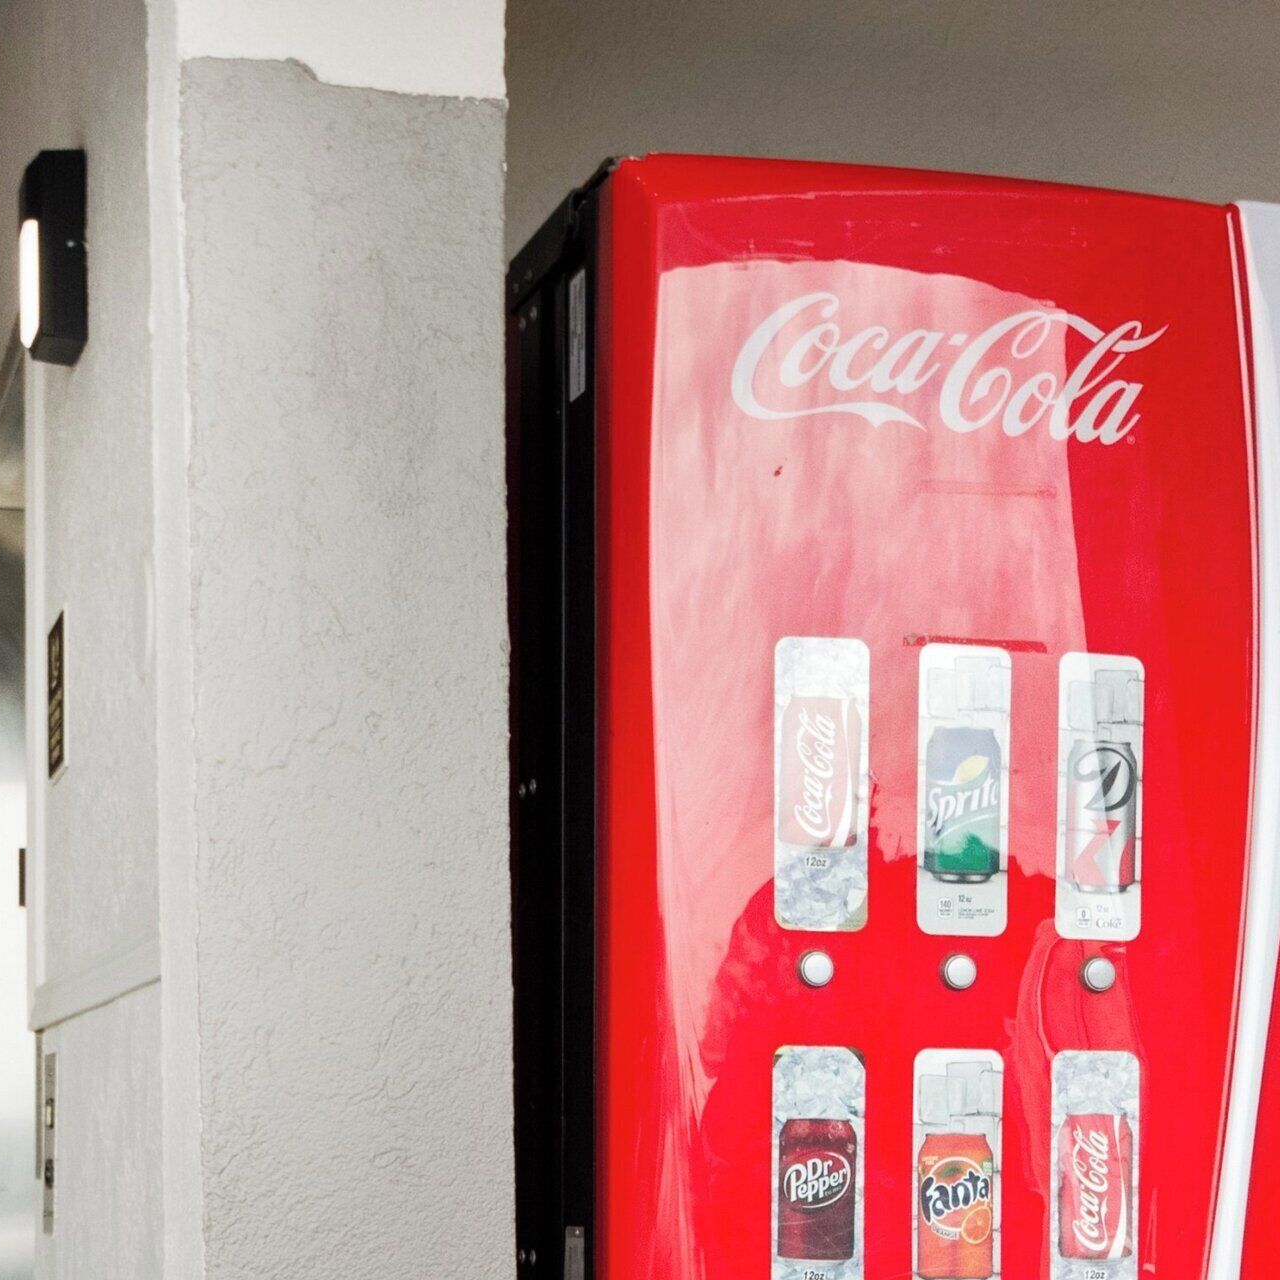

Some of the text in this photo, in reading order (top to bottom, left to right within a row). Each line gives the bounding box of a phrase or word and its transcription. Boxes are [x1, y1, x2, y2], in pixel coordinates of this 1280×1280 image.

[731, 292, 1169, 445] Coca-Cola
[794, 707, 836, 838] Coca-Cola
[927, 775, 998, 837] Sprite
[805, 855, 827, 868] 12oz
[789, 1163, 848, 1202] Pepper
[807, 1158, 832, 1181] Dr
[1072, 1124, 1108, 1251] Coca-Cola
[920, 1170, 990, 1225] Fanta
[804, 1270, 825, 1280] 12oz
[1084, 1269, 1106, 1280] 12oz
